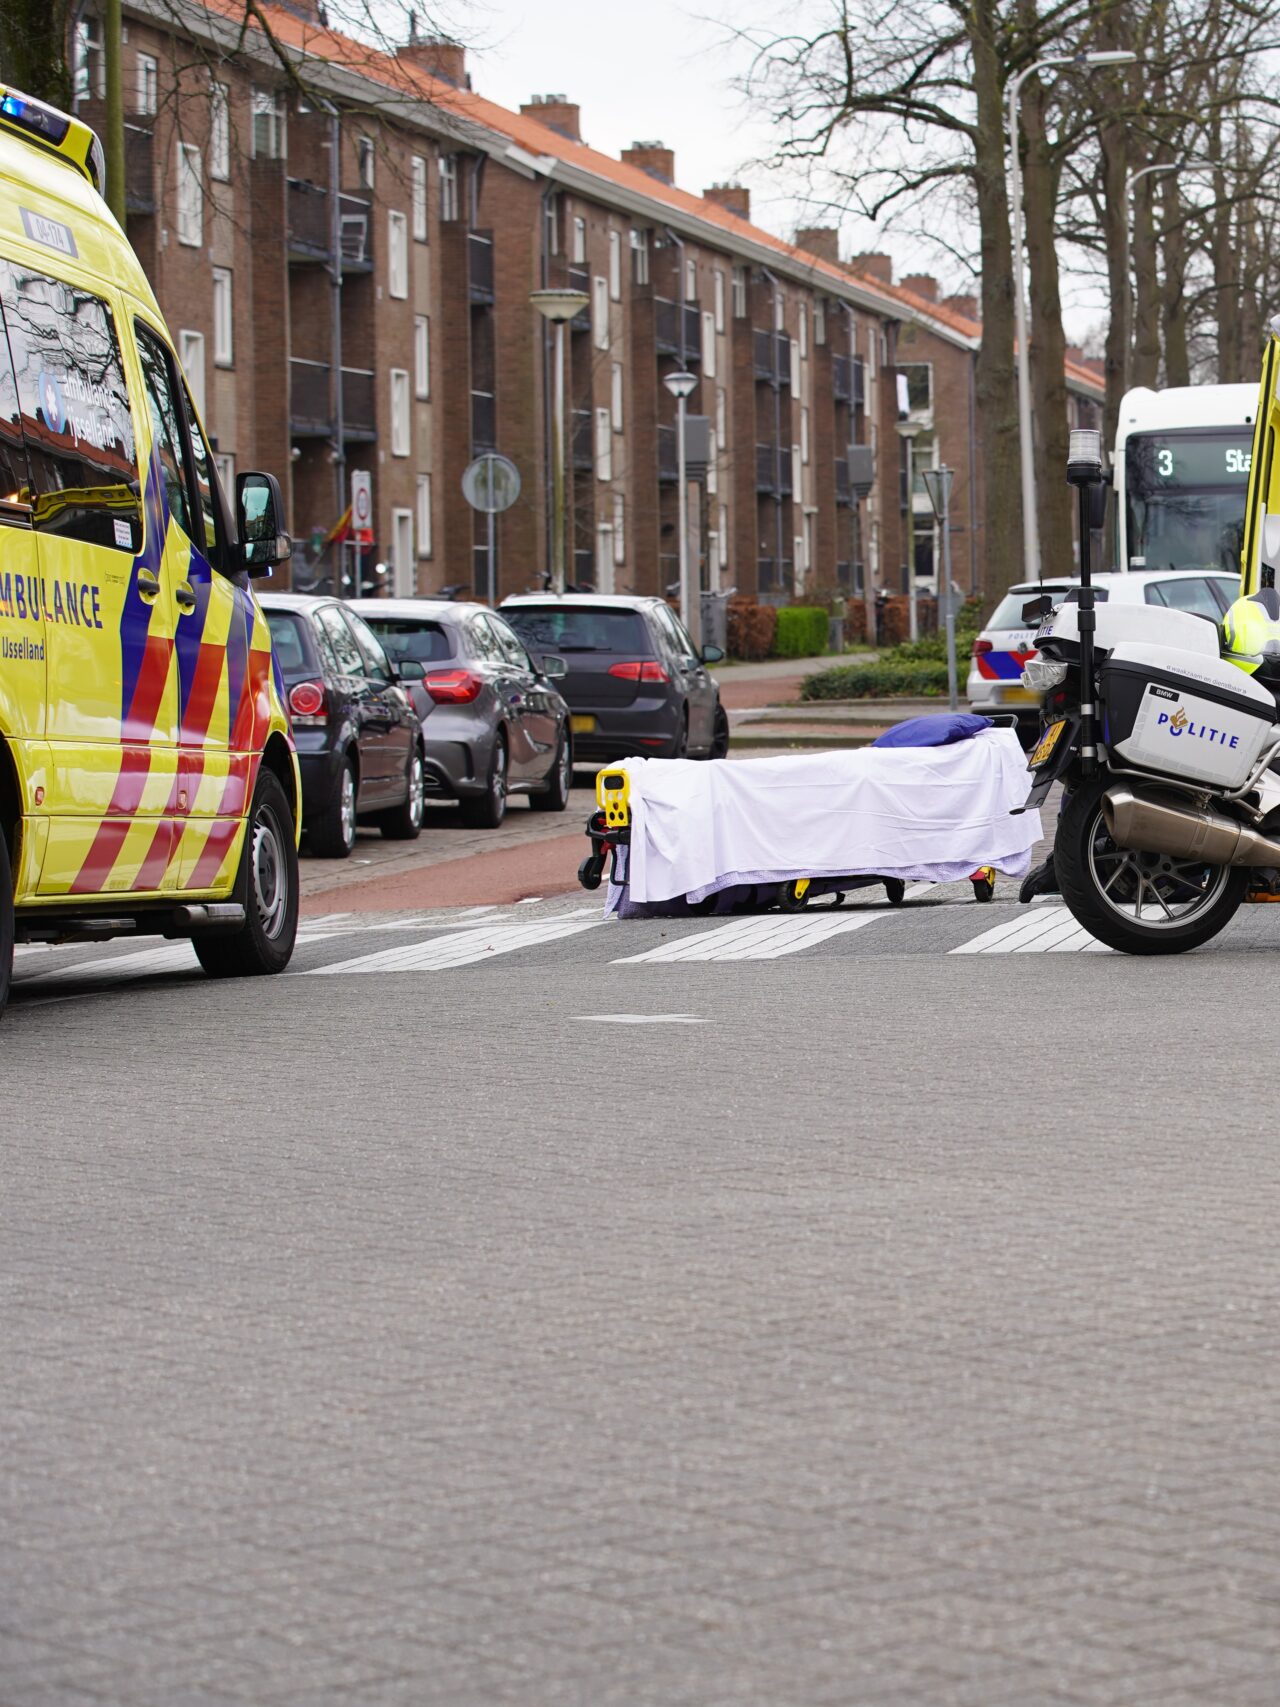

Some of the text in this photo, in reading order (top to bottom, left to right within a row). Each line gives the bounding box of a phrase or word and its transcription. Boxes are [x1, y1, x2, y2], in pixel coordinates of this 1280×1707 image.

[63, 370, 117, 412] ambulance
[1158, 448, 1252, 476] 3 Sta
[1008, 632, 1035, 640] POLIT
[1036, 625, 1054, 638] LITIE
[1171, 665, 1203, 680] waakzaam
[1203, 676, 1212, 684] en
[1156, 688, 1174, 699] BMW
[1157, 711, 1240, 749] POLITIE
